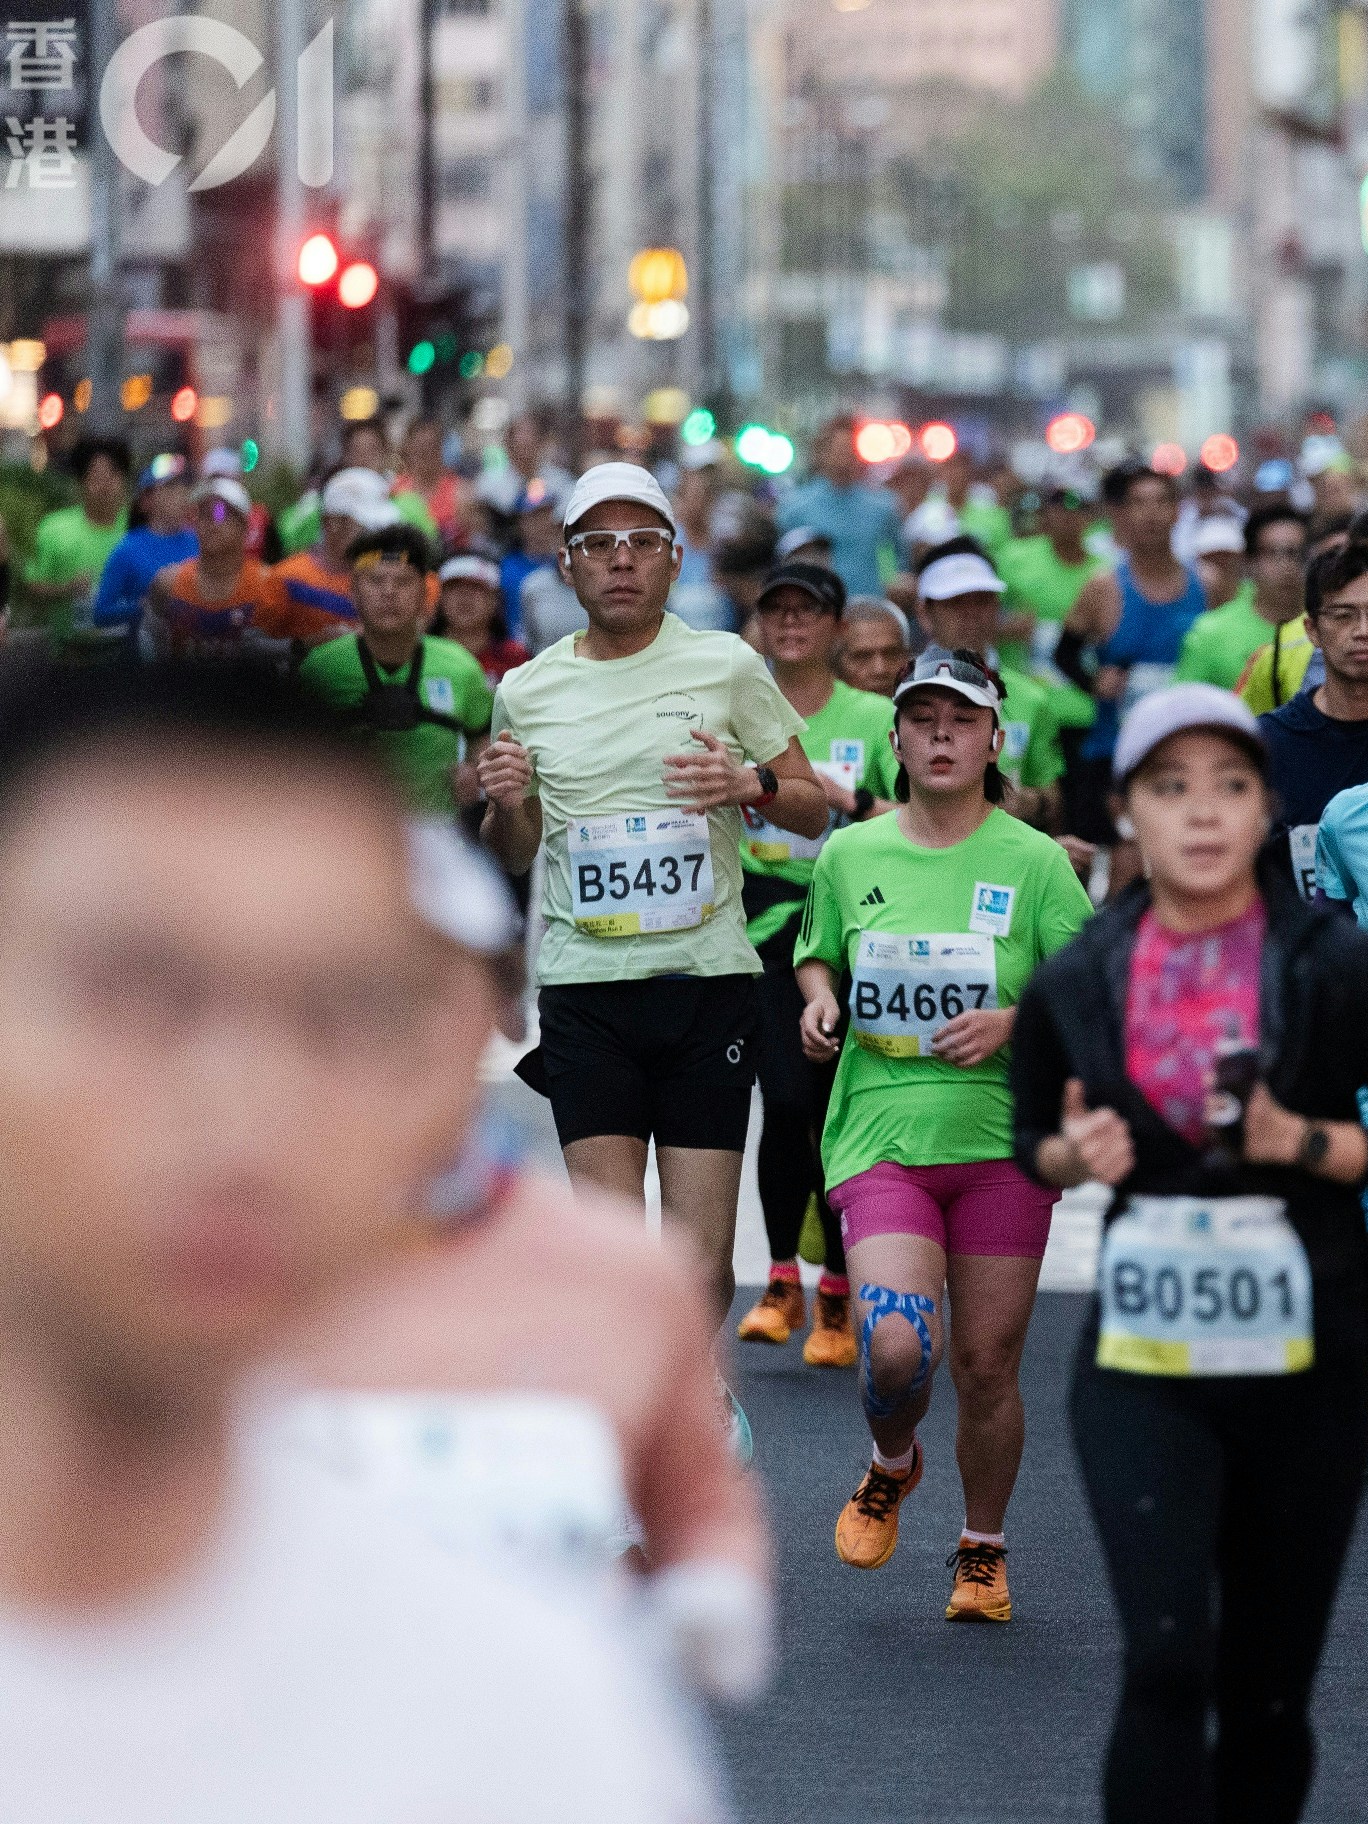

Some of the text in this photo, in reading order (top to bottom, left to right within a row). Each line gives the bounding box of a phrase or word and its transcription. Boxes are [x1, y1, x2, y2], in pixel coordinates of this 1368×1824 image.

[578, 853, 705, 904] B5437
[855, 981, 990, 1022] B4667
[1112, 1260, 1294, 1323] B0501
